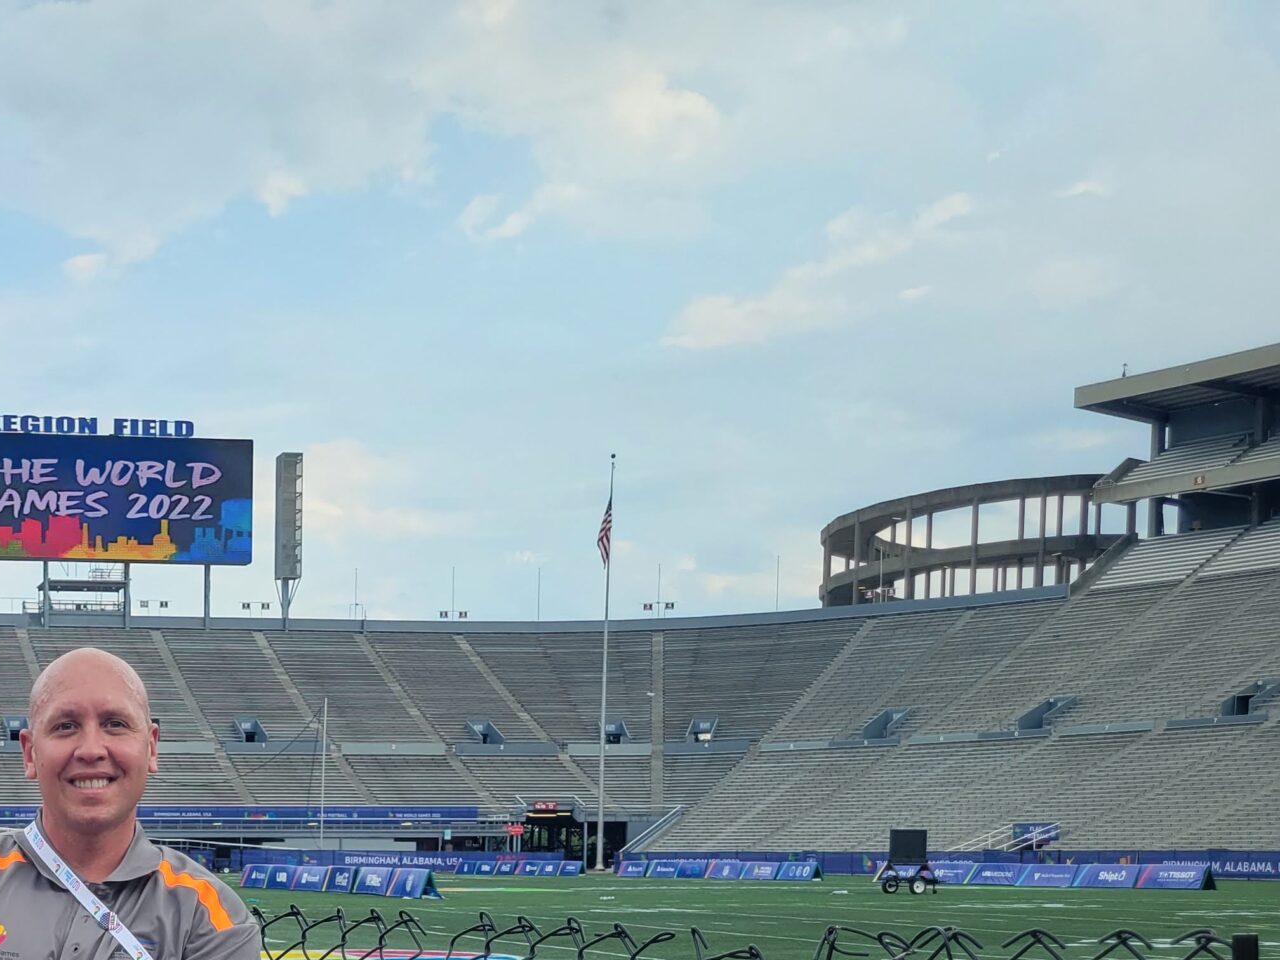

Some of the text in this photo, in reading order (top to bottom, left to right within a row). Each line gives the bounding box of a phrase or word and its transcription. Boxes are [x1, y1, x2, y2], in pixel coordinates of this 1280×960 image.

[113, 418, 195, 438] FIELD
[75, 458, 223, 490] WORLD
[125, 493, 215, 521] 2022
[1098, 870, 1119, 883] Shipt
